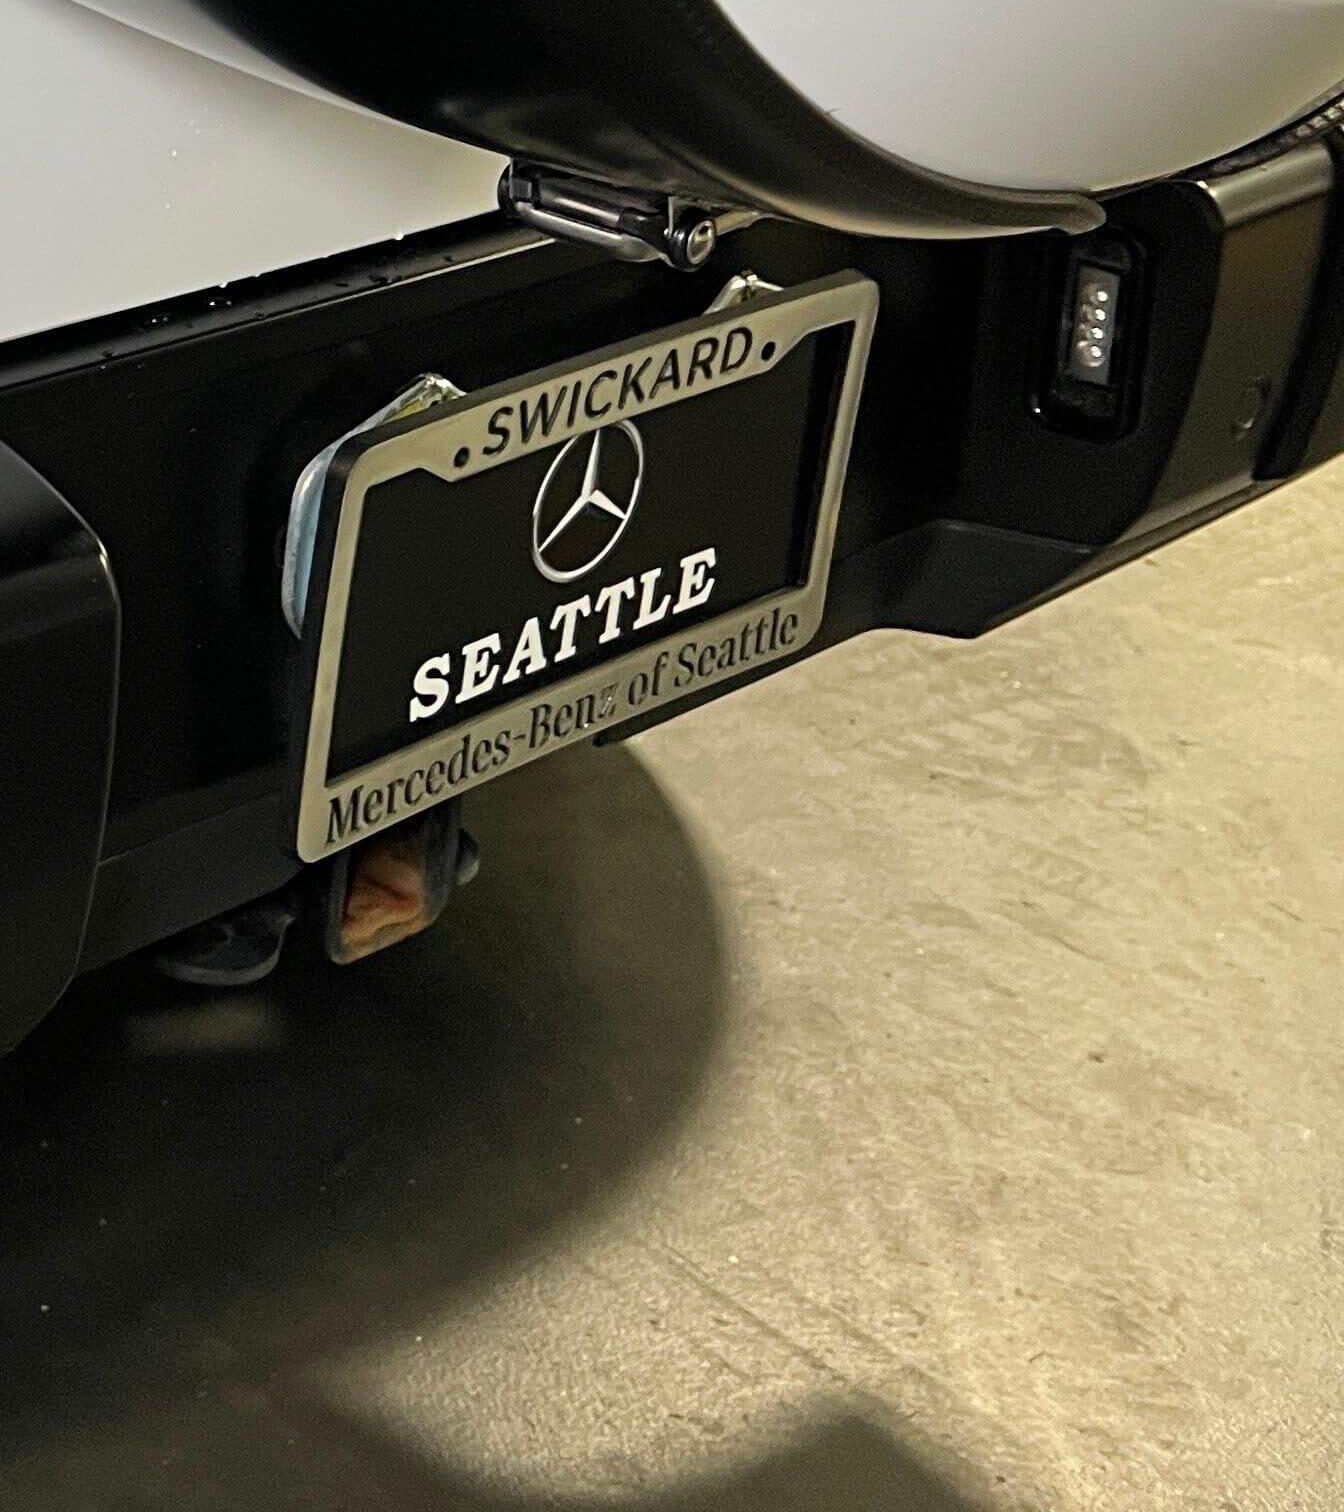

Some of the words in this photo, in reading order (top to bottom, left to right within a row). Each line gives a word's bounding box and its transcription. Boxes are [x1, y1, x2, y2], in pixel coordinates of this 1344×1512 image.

[486, 326, 753, 456] SWICKARD
[408, 547, 717, 723] SEATTLE
[325, 682, 619, 844] Mercedes-Benz
[628, 650, 670, 706] of
[673, 607, 799, 680] Seattle
